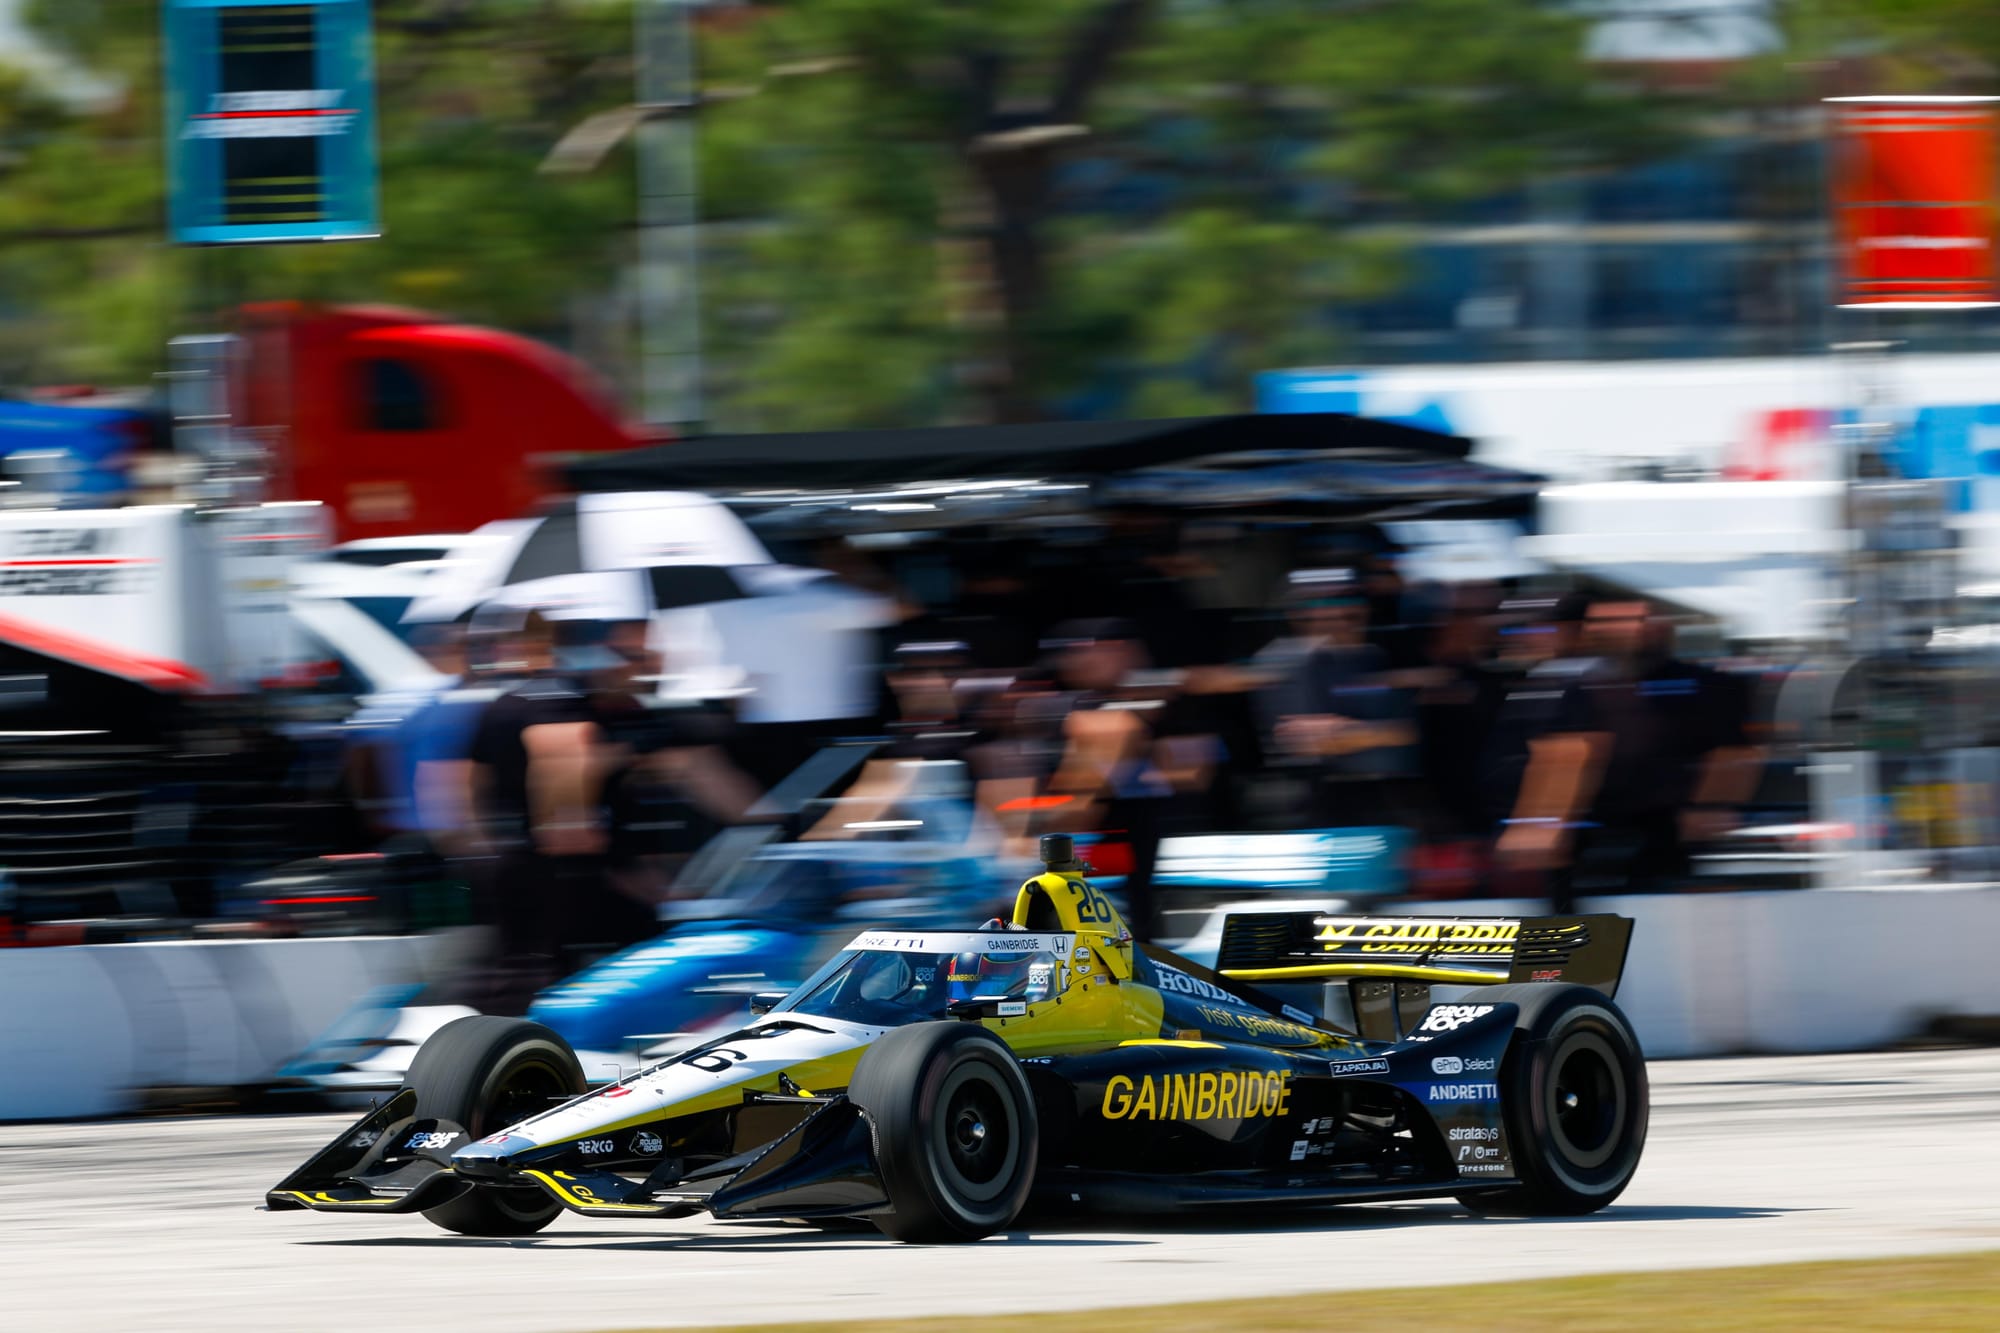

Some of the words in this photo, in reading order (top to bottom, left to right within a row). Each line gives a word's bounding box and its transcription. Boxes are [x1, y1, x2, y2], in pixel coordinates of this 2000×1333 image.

[1067, 881, 1112, 923] 26
[988, 939, 1039, 951] GAINBRIDGE
[1028, 968, 1050, 976] GROUP
[1028, 975, 1049, 985] 1001
[1430, 1005, 1495, 1018] GROUP
[1464, 1058, 1495, 1070] Select
[1101, 1069, 1292, 1121] GAINBRIDGE
[1429, 1083, 1497, 1100] ANDRETTI
[413, 1132, 460, 1141] GROUP
[1448, 1127, 1499, 1142] stratasys
[640, 1138, 662, 1146] ROUGH
[1457, 1164, 1505, 1174] Firestone
